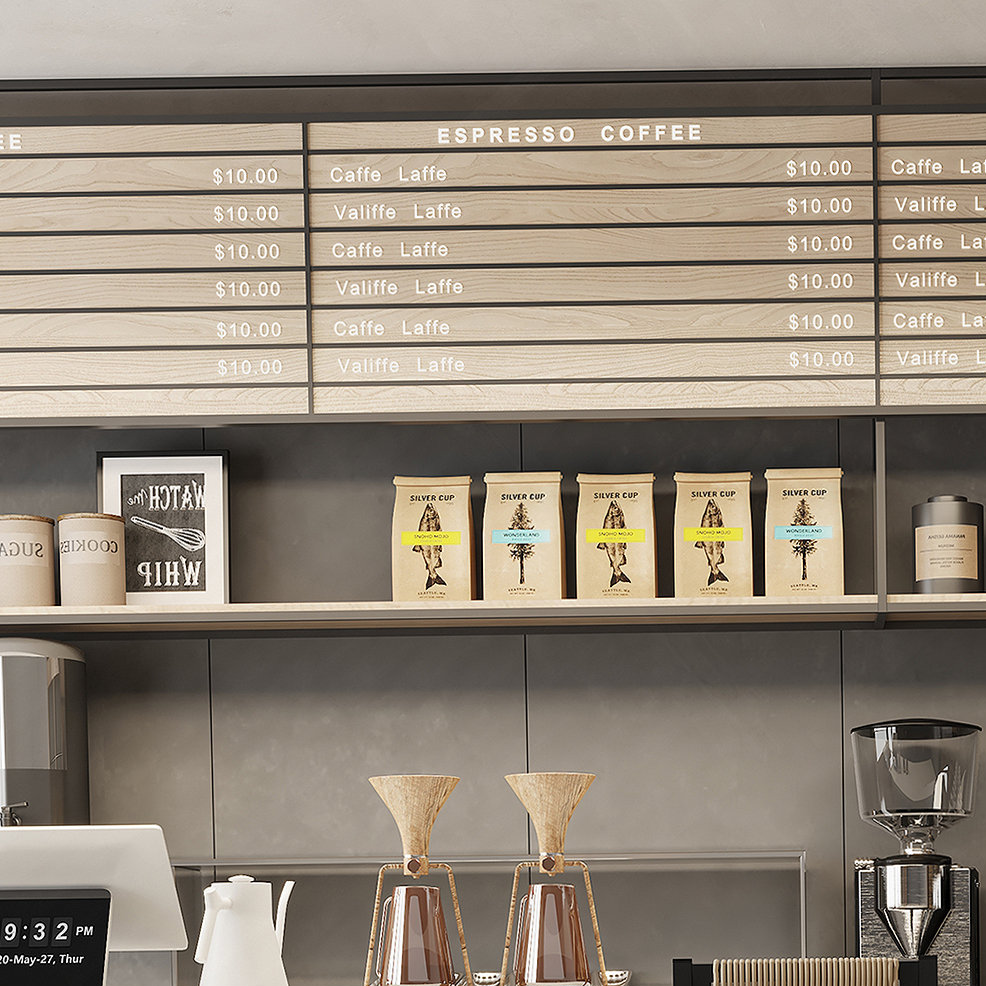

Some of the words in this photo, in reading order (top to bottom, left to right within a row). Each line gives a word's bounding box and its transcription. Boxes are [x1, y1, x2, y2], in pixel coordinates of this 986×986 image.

[437, 126, 574, 144] ESPRESSO
[600, 124, 701, 142] COFFEE
[330, 166, 381, 183] Caffe
[399, 165, 447, 182] Laffe
[786, 159, 852, 178] $10.00
[891, 158, 943, 175] Caffe
[212, 167, 278, 186] $10.00
[333, 204, 396, 220] Valiffe
[414, 203, 462, 219] Laffe
[787, 197, 852, 216] $10.00
[894, 196, 957, 213] Valiffe
[213, 205, 279, 224] $10.00
[332, 242, 383, 258] Caffe
[400, 241, 448, 257] Laffe
[787, 235, 853, 254] $10.00
[892, 234, 943, 251] Caffe
[214, 243, 280, 262] $10.00
[335, 279, 398, 296] Valiffe
[415, 278, 463, 295] Laffe
[788, 273, 853, 291] $10.00
[895, 271, 958, 288] Valiffe
[215, 280, 280, 299] $10.00
[333, 320, 385, 337] Caffe
[402, 319, 450, 335] Laffe
[788, 313, 854, 332] $10.00
[893, 312, 944, 329] Caffe
[216, 321, 281, 340] $10.00
[337, 357, 400, 374] Valiffe
[417, 356, 465, 373] Laffe
[789, 351, 854, 369] $10.00
[896, 349, 959, 366] Valiffe
[217, 359, 282, 377] $10.00
[409, 494, 437, 502] SILVER
[501, 493, 527, 501] SILVER
[528, 492, 546, 500] CUP
[593, 491, 621, 500] SILVER
[622, 491, 639, 499] CUP
[691, 490, 719, 498] SILVER
[719, 490, 736, 498] CUP
[782, 489, 810, 497] SILVER
[810, 489, 828, 497] CUP
[75, 925, 94, 937] PM
[0, 954, 56, 967] 0-May-27,
[59, 953, 85, 964] Thur
